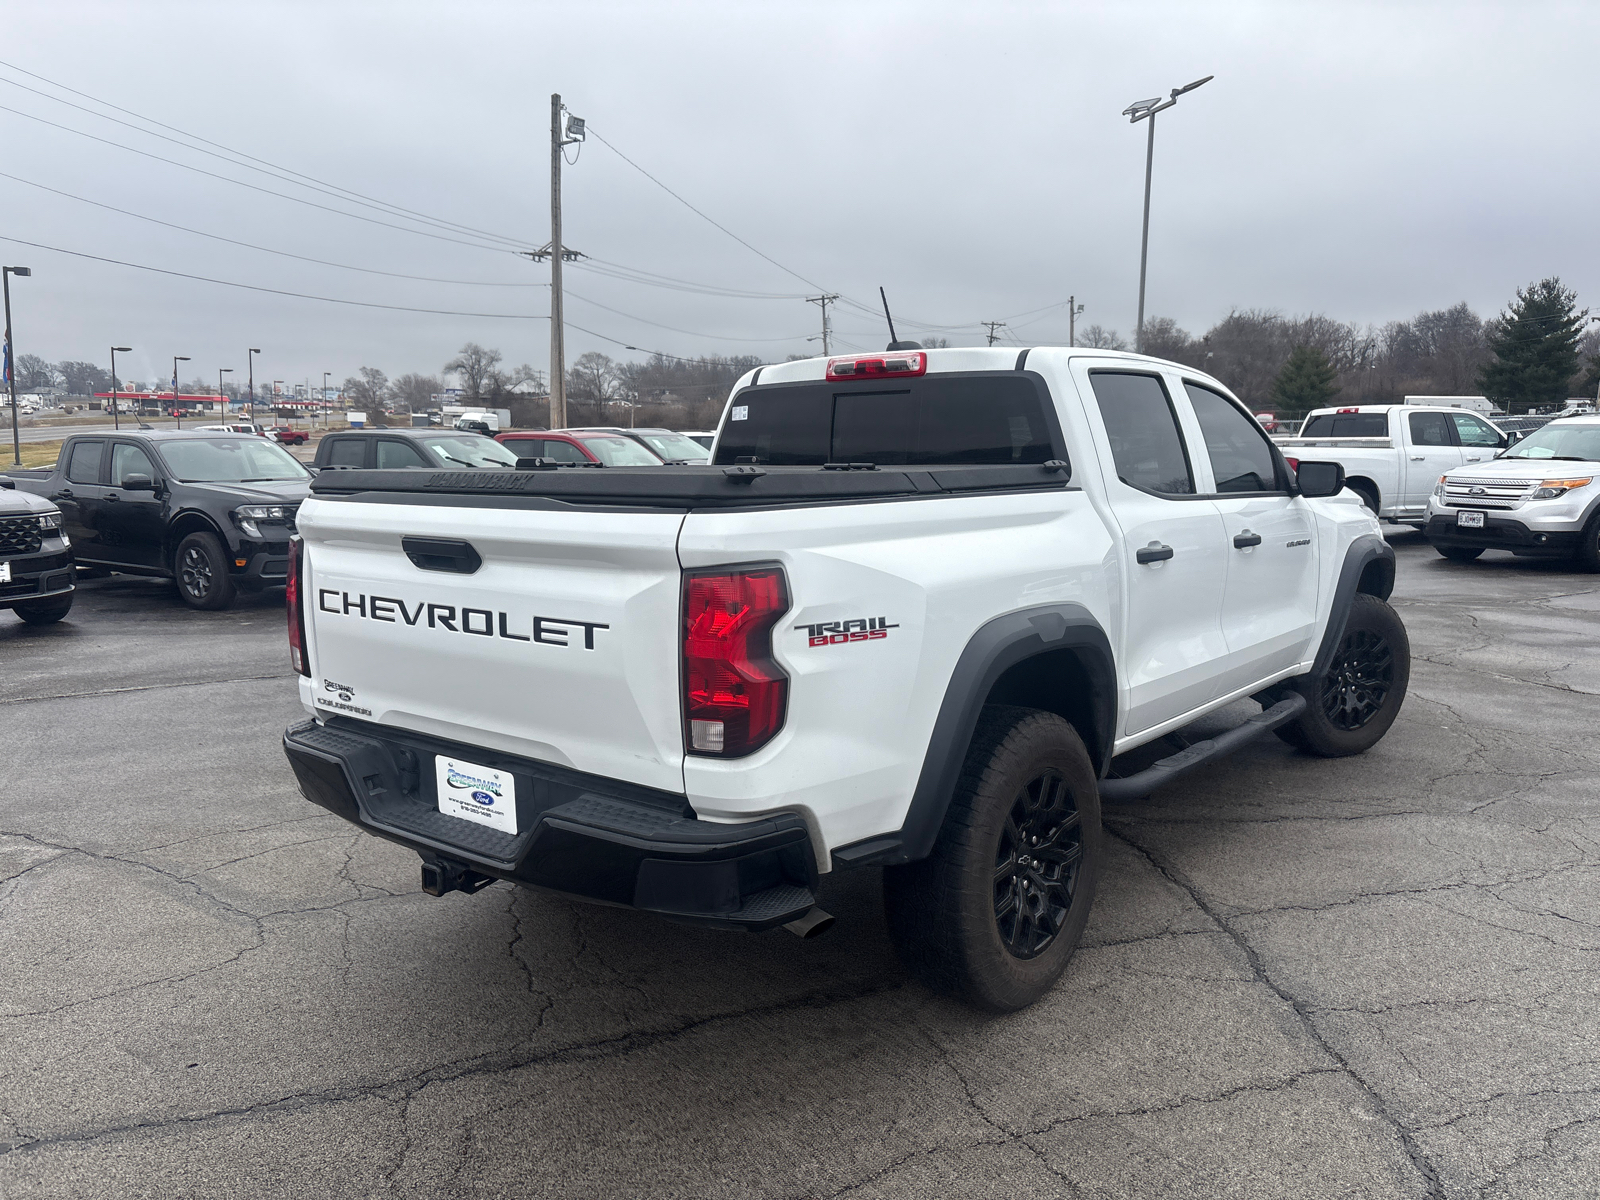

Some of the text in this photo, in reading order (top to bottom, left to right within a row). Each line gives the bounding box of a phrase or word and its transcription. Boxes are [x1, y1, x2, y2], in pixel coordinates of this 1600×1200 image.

[423, 472, 535, 491] DIAMONDBACK
[319, 588, 610, 650] CHEVROLET
[794, 616, 900, 637] TRAIL
[808, 629, 887, 648] BOSS
[475, 791, 491, 804] Ford
